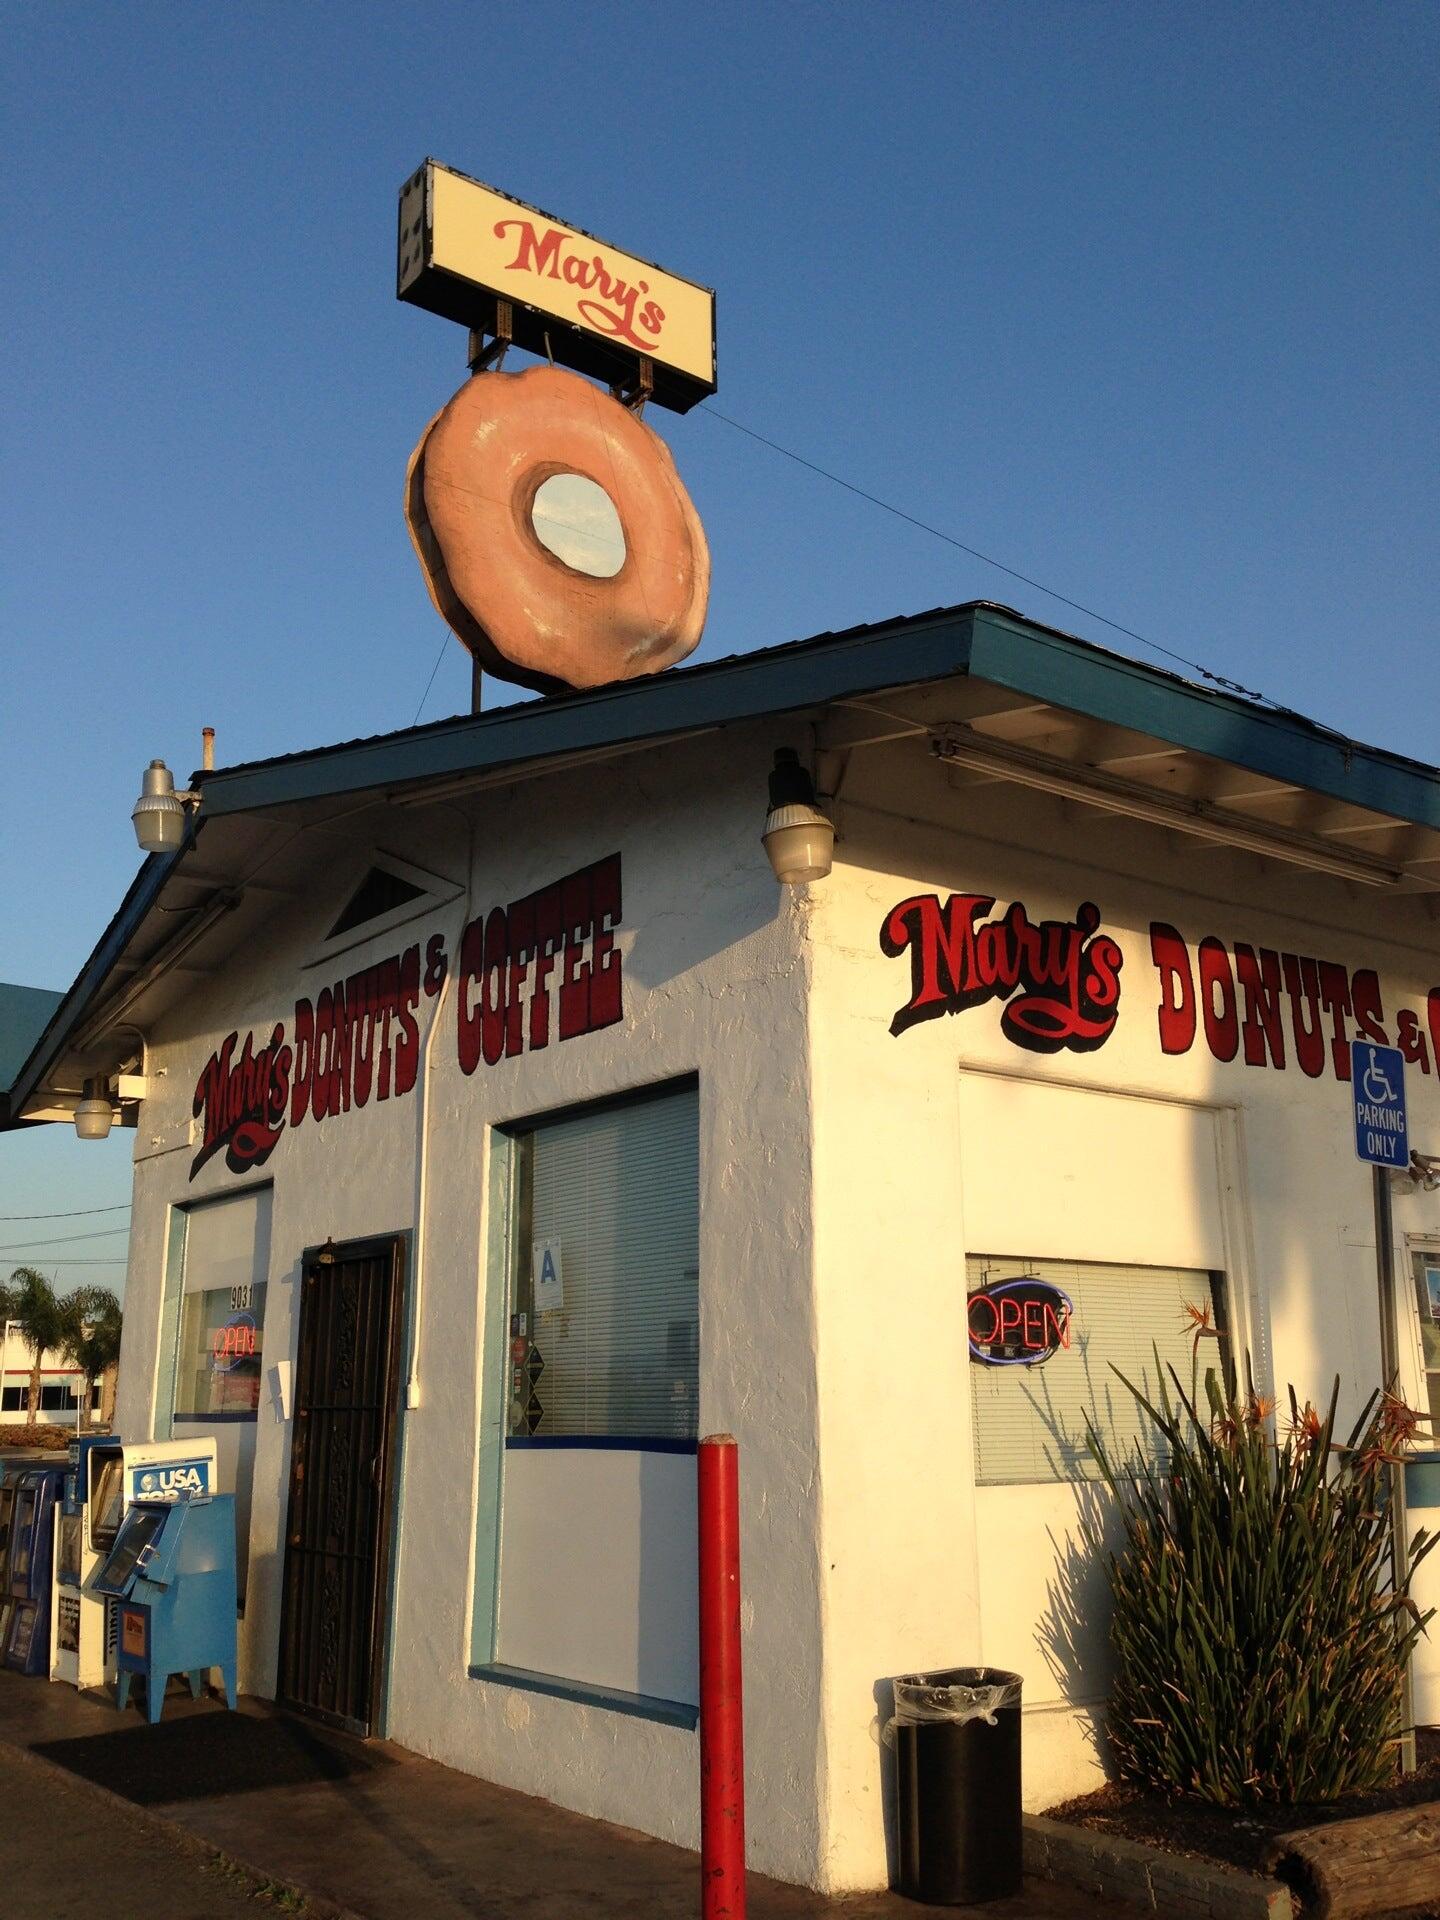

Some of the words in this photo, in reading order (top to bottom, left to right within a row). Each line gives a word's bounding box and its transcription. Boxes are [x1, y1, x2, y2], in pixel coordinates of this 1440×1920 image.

[493, 219, 666, 350] Mary's
[879, 893, 1124, 1054] Mary's
[1149, 921, 1388, 1082] DONUTS
[1396, 1008, 1431, 1075] &
[189, 1021, 293, 1184] Mary's
[289, 942, 421, 1129] DONUTS
[424, 933, 448, 997] &
[457, 851, 623, 1076] COFFEE
[1357, 1102, 1405, 1133] PARKING
[1367, 1131, 1397, 1158] ONLY
[540, 1249, 557, 1284] A
[231, 1286, 253, 1310] 9031
[967, 1294, 1071, 1351] OPEN
[213, 1325, 257, 1359] OPEN
[159, 1467, 202, 1490] USA
